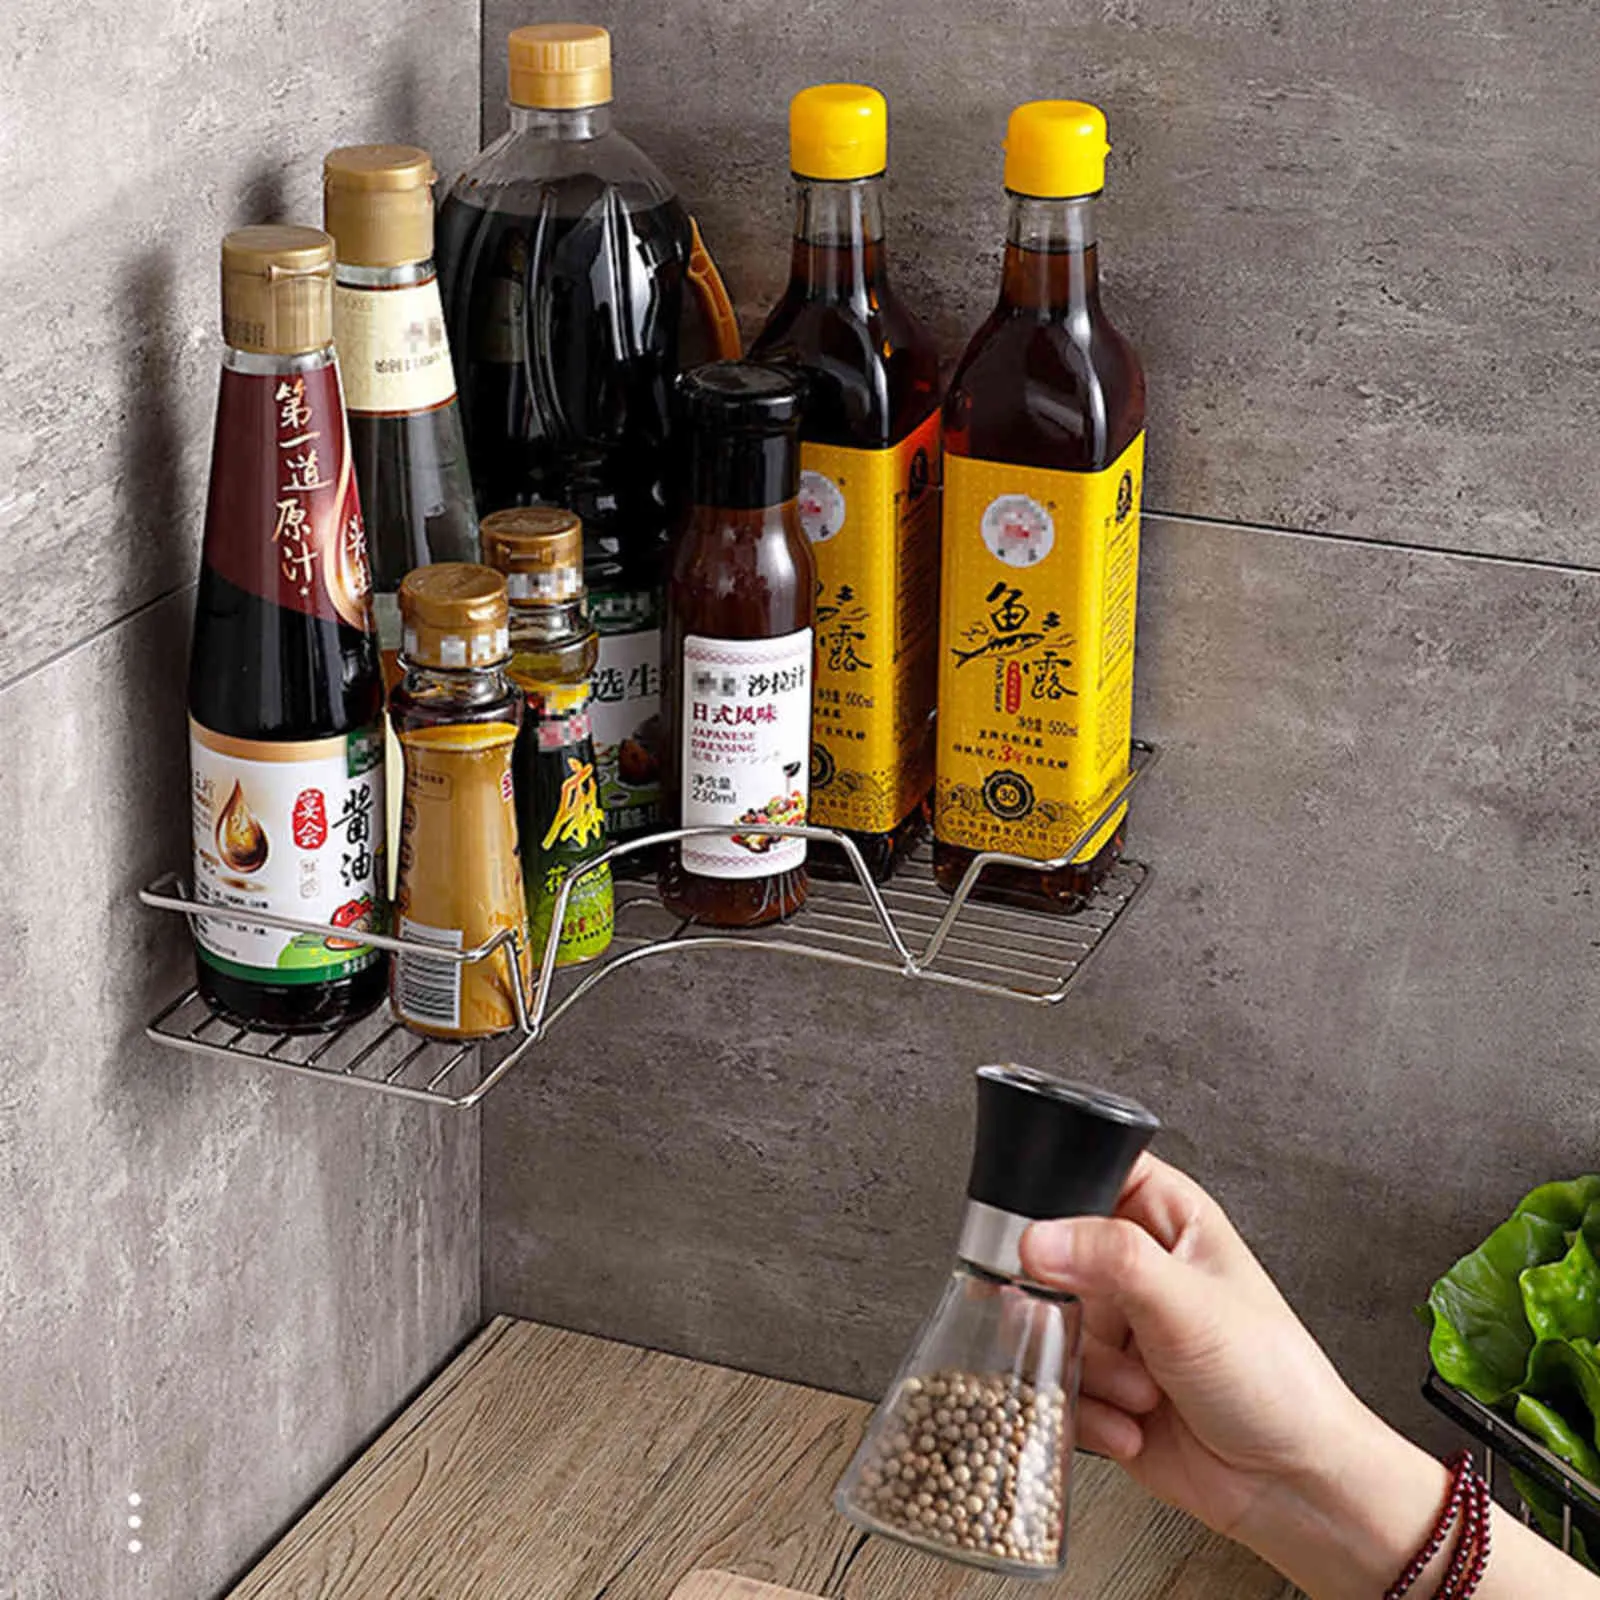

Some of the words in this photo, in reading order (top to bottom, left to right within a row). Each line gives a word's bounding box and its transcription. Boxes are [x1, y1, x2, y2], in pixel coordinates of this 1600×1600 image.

[272, 378, 334, 582] 第一道原汁
[748, 664, 805, 698] 沙拉汁
[693, 702, 778, 725] 日式风味
[692, 726, 756, 741] JAPANESE
[691, 738, 757, 753] DRESSING
[692, 773, 732, 790] 净含量
